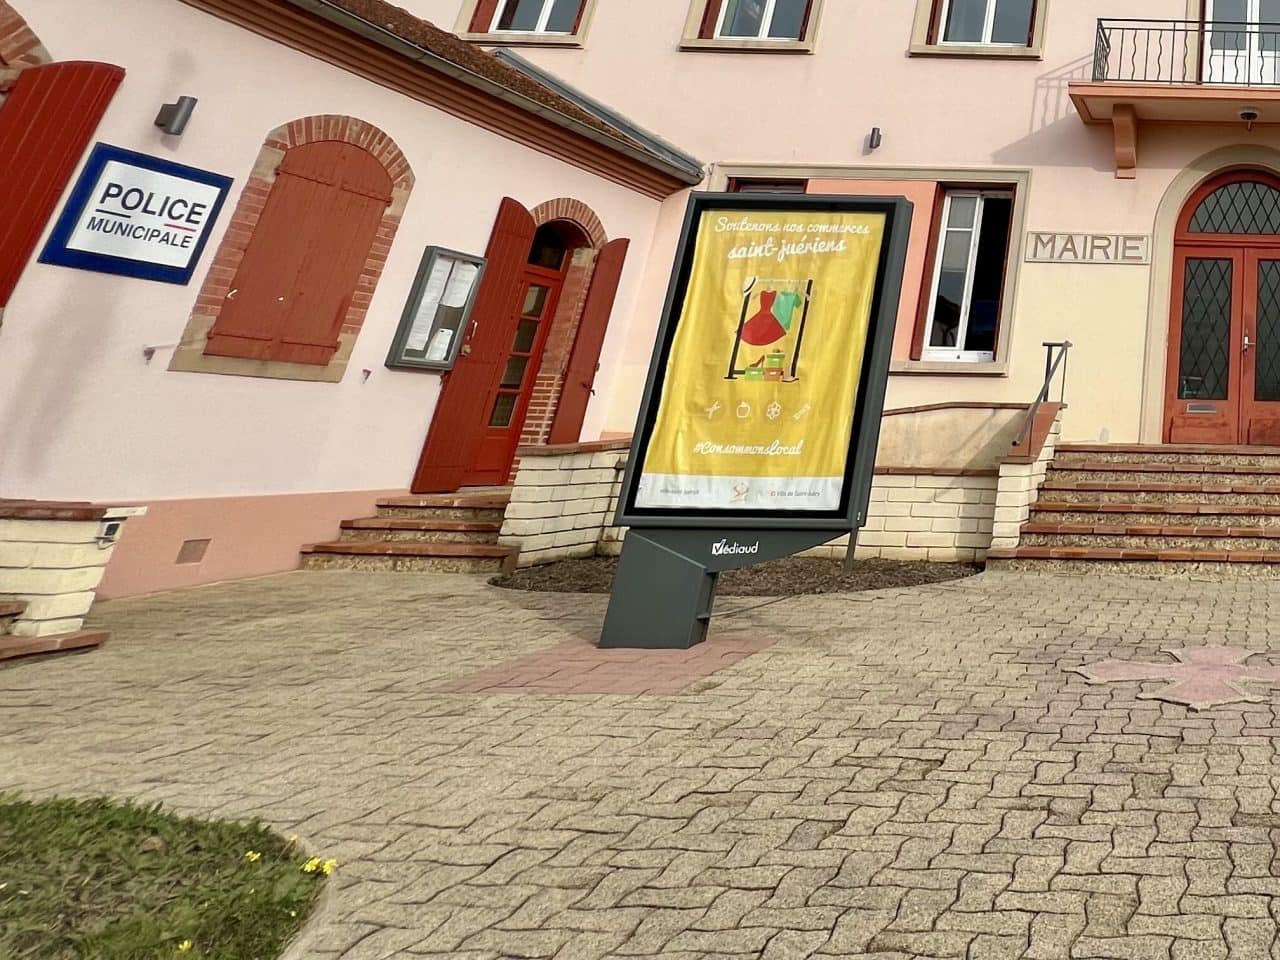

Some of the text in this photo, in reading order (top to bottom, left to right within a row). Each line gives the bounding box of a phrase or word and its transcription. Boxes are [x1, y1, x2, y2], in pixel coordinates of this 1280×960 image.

[99, 182, 207, 225] POLICE
[86, 216, 193, 249] MUNICIPALE
[783, 222, 804, 233] nos
[806, 222, 871, 234] commerces
[727, 235, 848, 262] saint-juériens
[1033, 233, 1145, 260] MAIRIE
